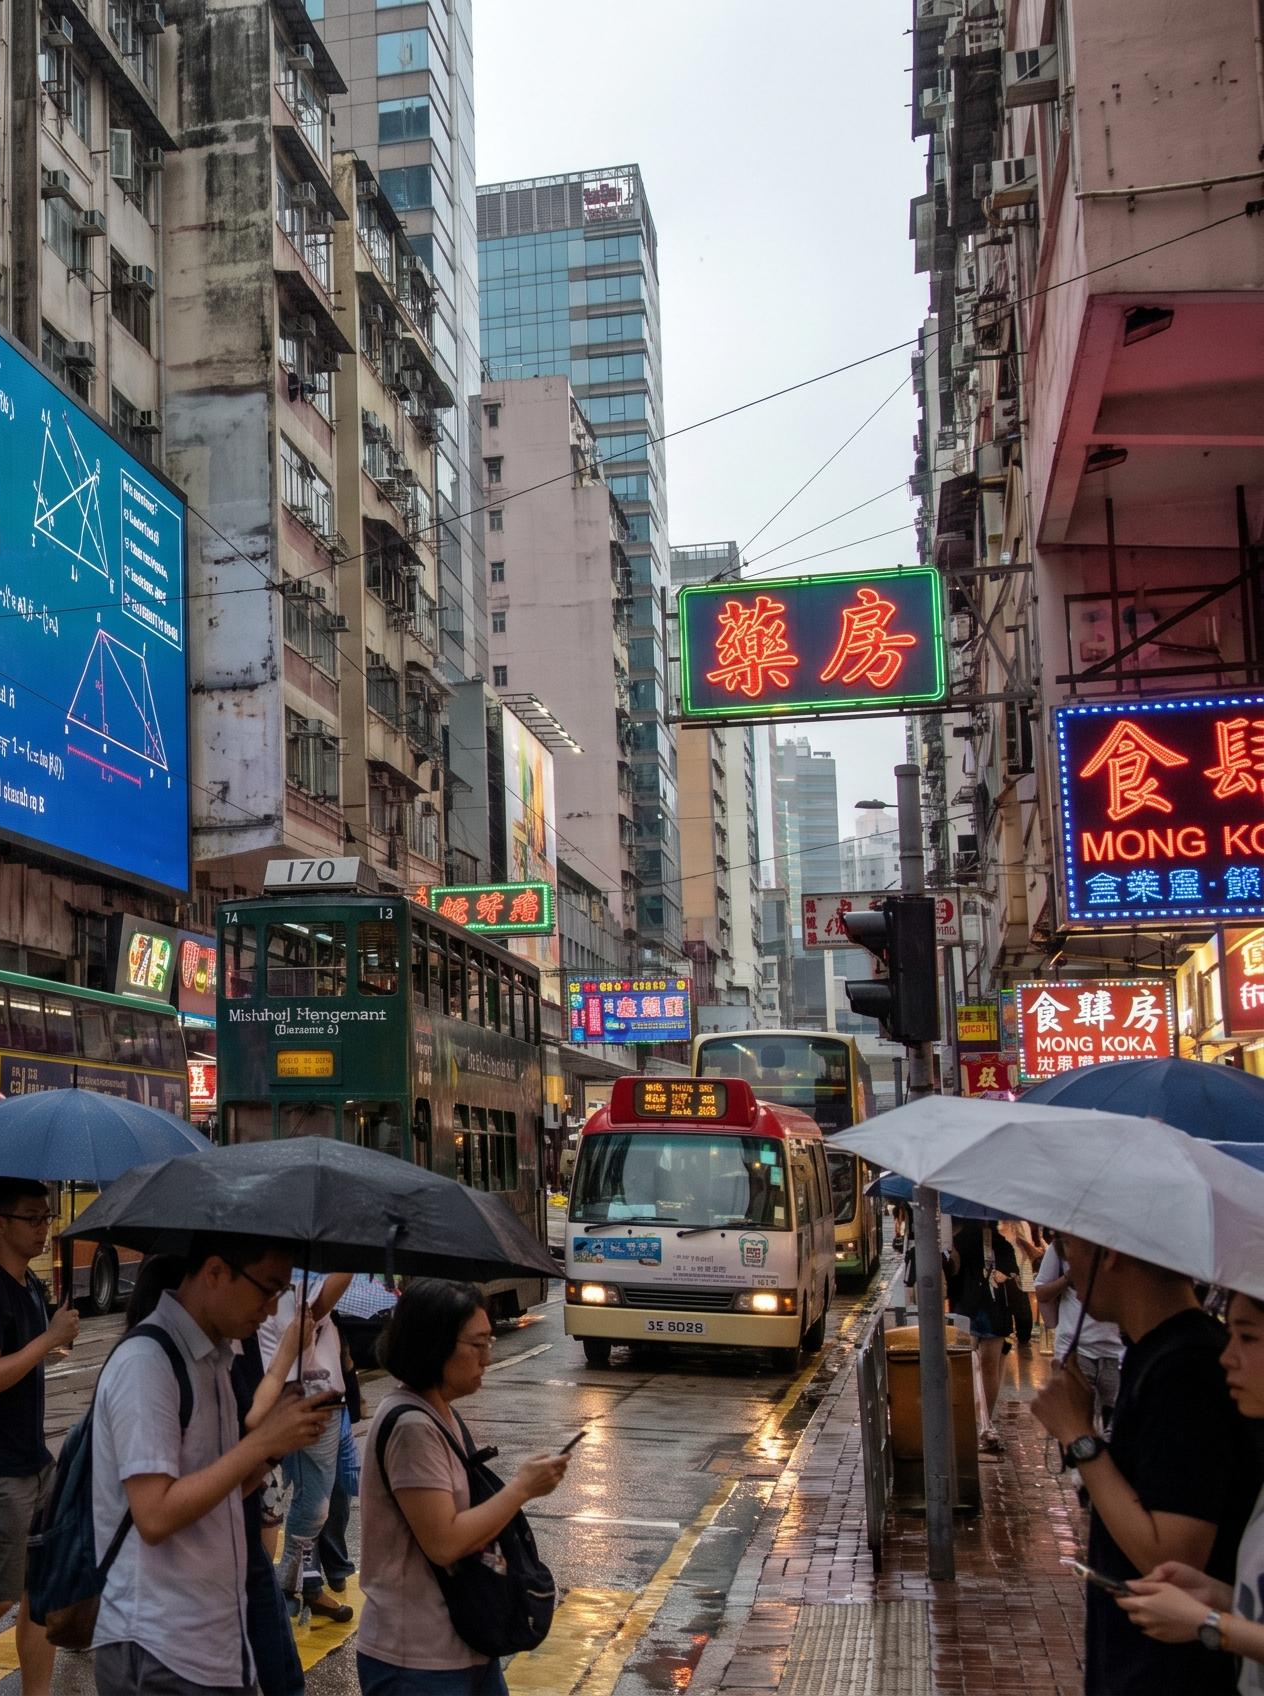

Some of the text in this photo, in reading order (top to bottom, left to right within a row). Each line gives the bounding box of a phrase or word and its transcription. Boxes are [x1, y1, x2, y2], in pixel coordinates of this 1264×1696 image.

[706, 587, 917, 698] 藥房
[1082, 826, 1207, 862] MONG
[286, 860, 336, 882] 170
[1037, 1035, 1157, 1053] MONG KOKA
